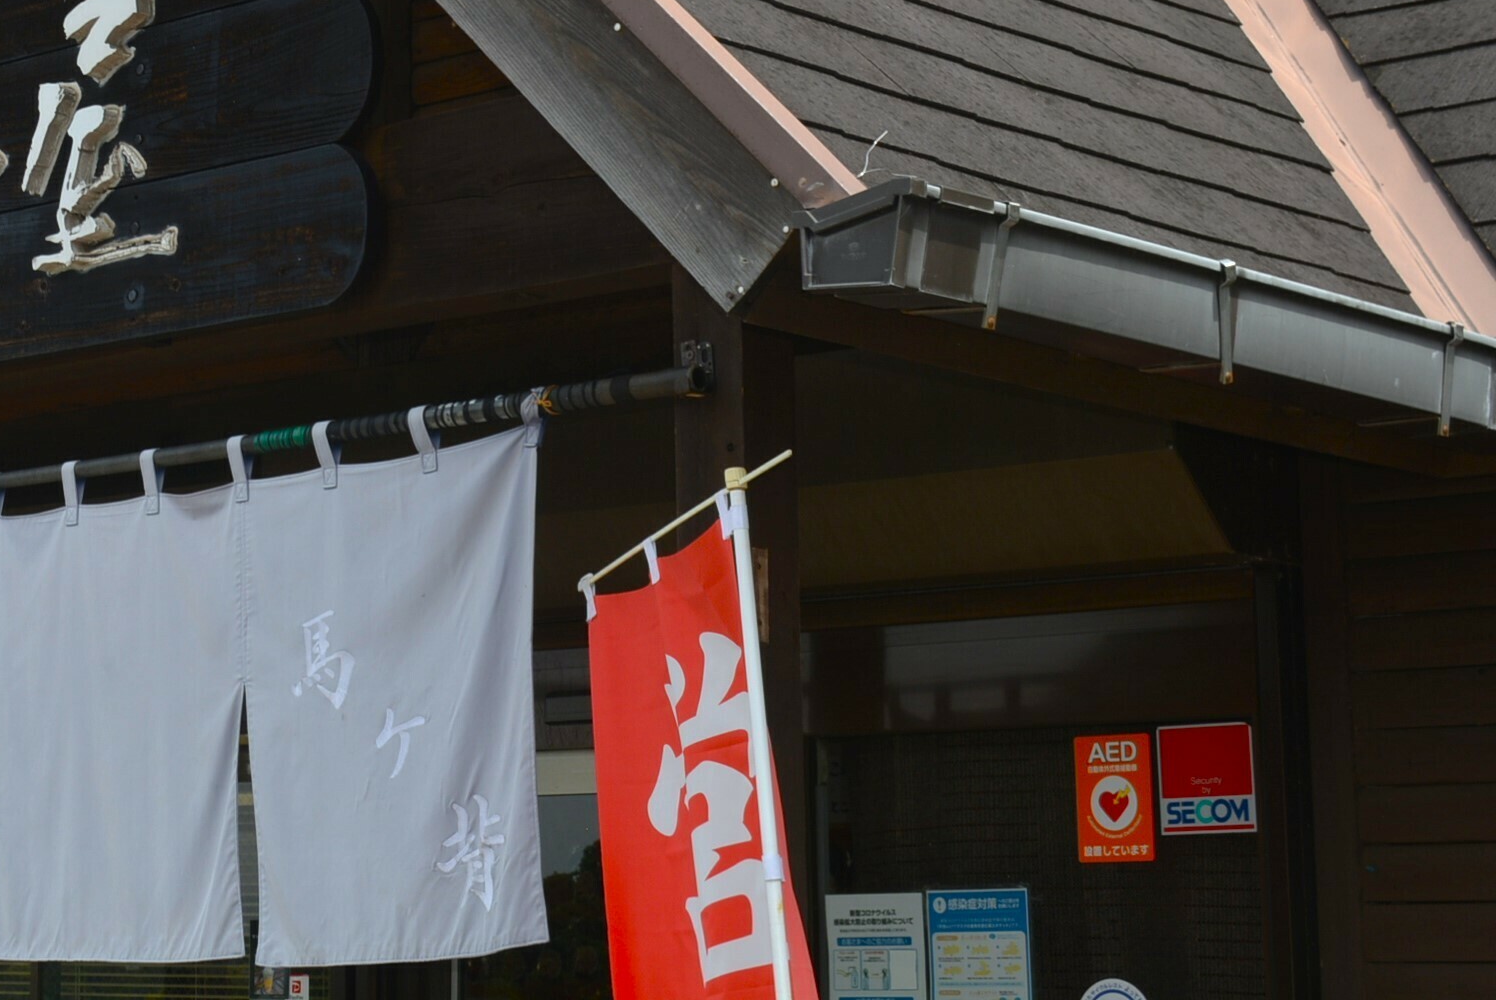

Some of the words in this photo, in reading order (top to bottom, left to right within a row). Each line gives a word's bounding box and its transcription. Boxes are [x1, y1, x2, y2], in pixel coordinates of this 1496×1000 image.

[1088, 741, 1137, 764] AED
[1190, 776, 1222, 786] Security
[1202, 786, 1211, 794] by
[1166, 798, 1250, 825] SECOM
[948, 897, 998, 911] 感染症対策
